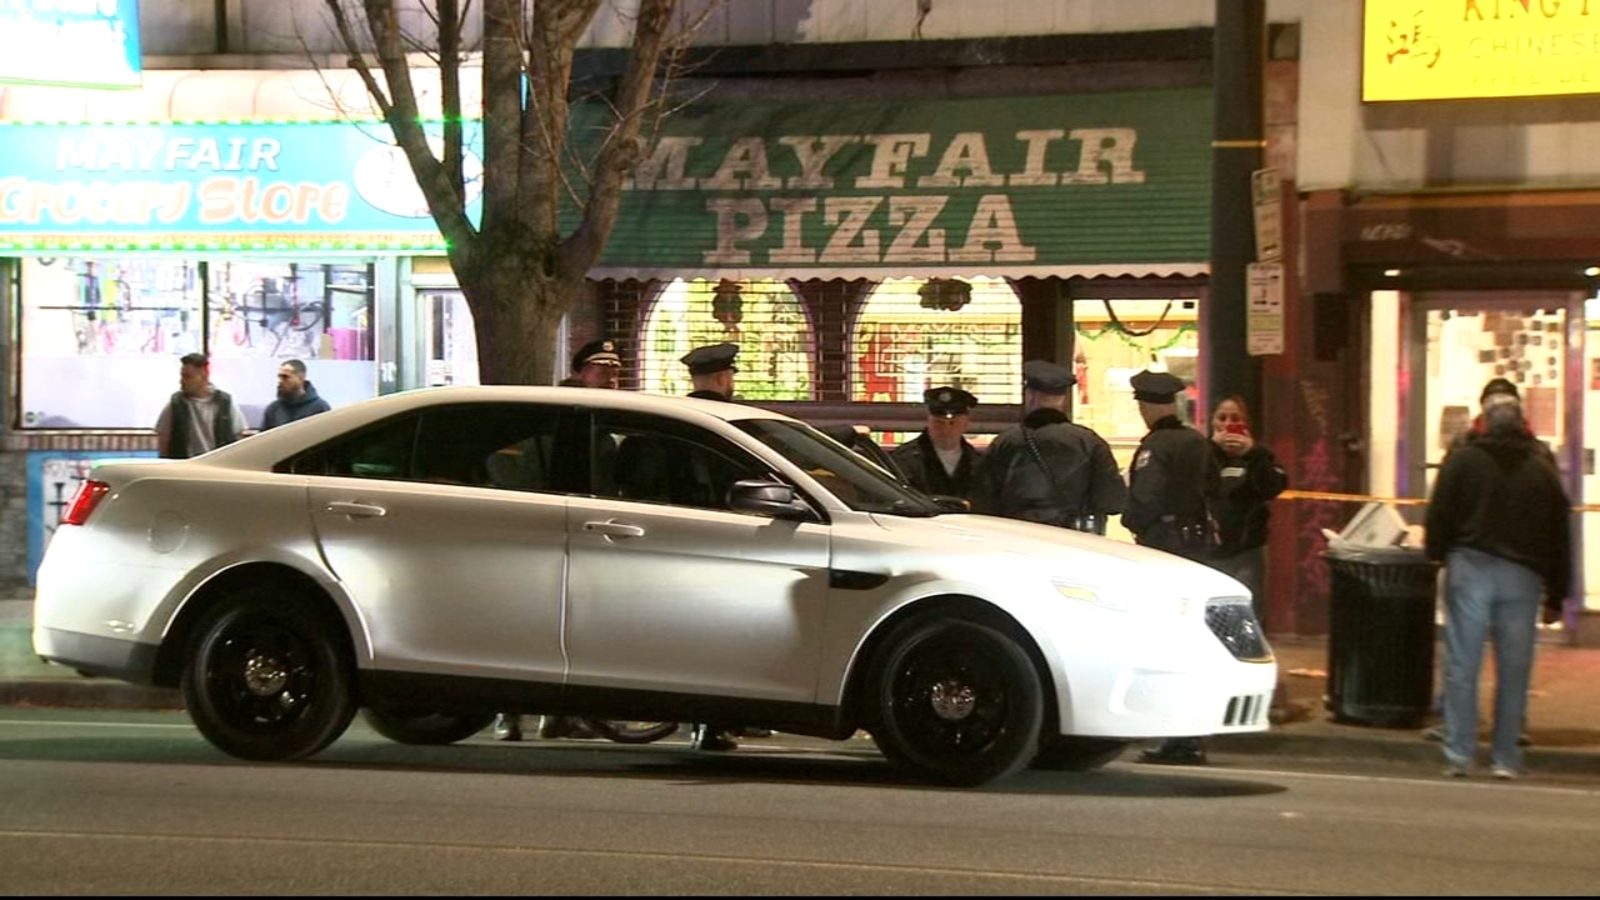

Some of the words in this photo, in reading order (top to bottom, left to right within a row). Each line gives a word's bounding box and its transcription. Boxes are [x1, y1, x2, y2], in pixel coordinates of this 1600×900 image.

[56, 137, 281, 172] MAYFAIR
[622, 127, 1145, 189] MAYFAIR
[0, 177, 190, 224] Grocery
[199, 175, 349, 224] Store
[703, 194, 1036, 264] PIZZA
